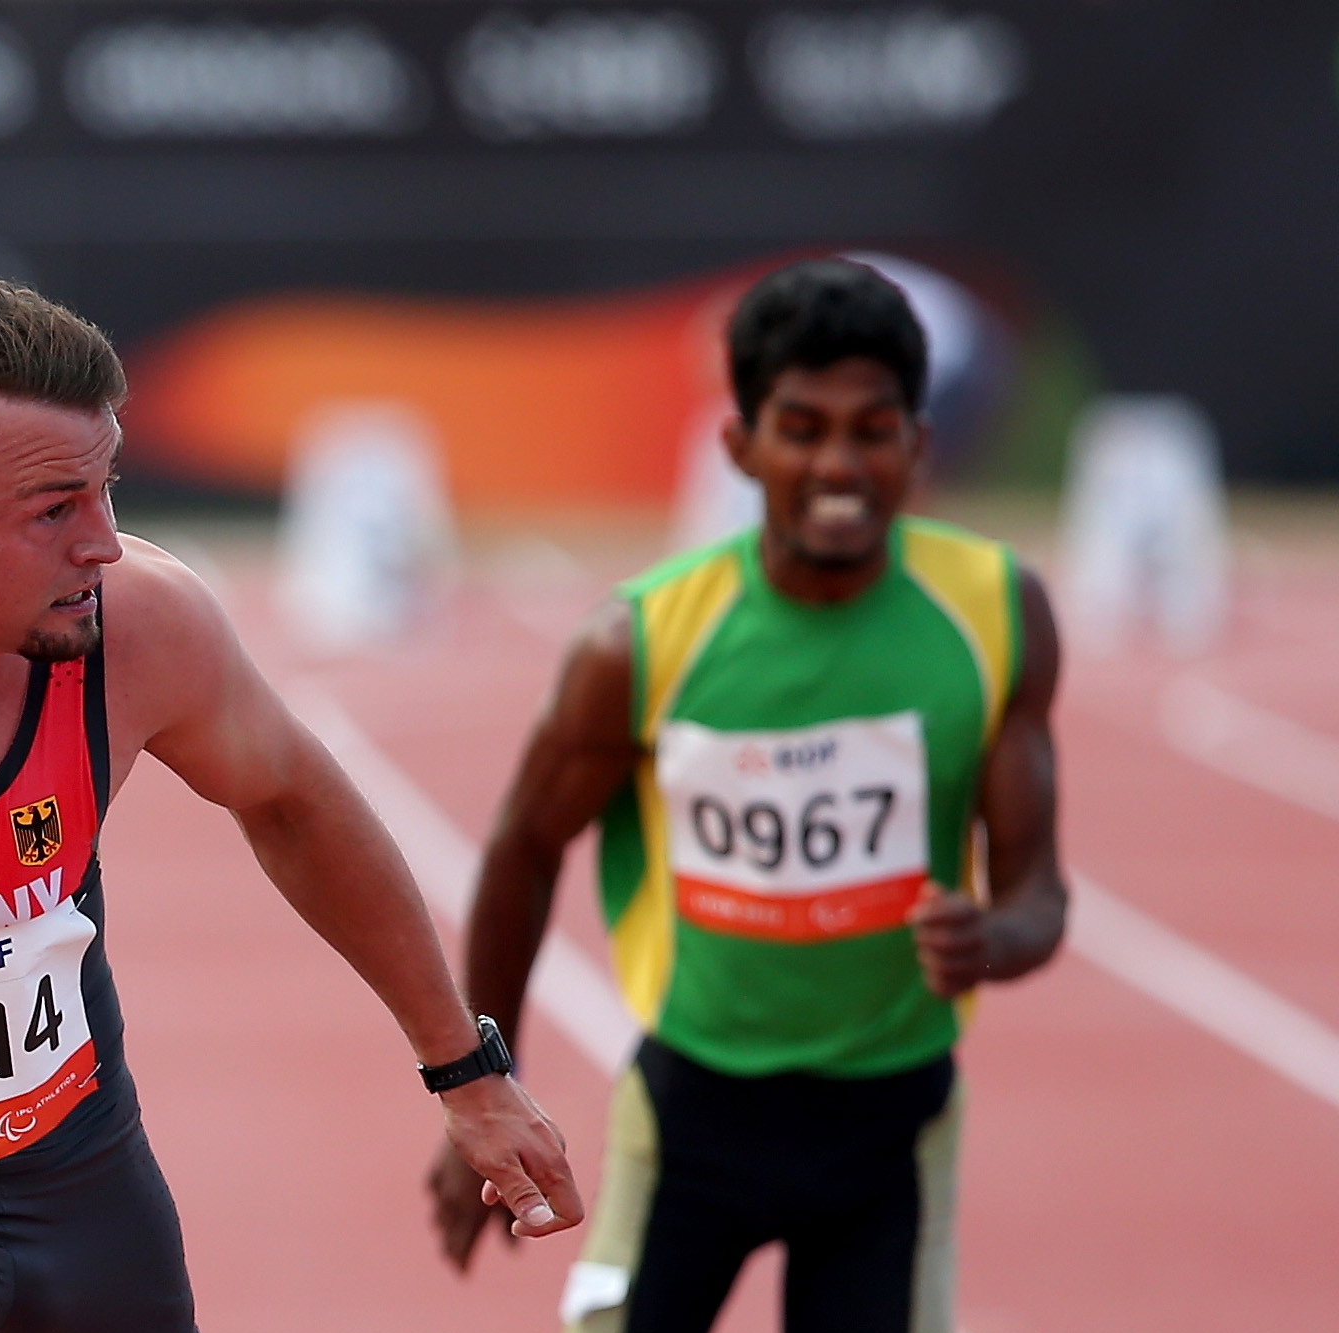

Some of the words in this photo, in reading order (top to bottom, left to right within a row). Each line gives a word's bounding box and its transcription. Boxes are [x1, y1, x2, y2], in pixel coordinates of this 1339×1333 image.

[691, 786, 895, 872] 0967
[15, 1106, 34, 1118] IPC
[35, 1072, 78, 1110] ATHLETICS
